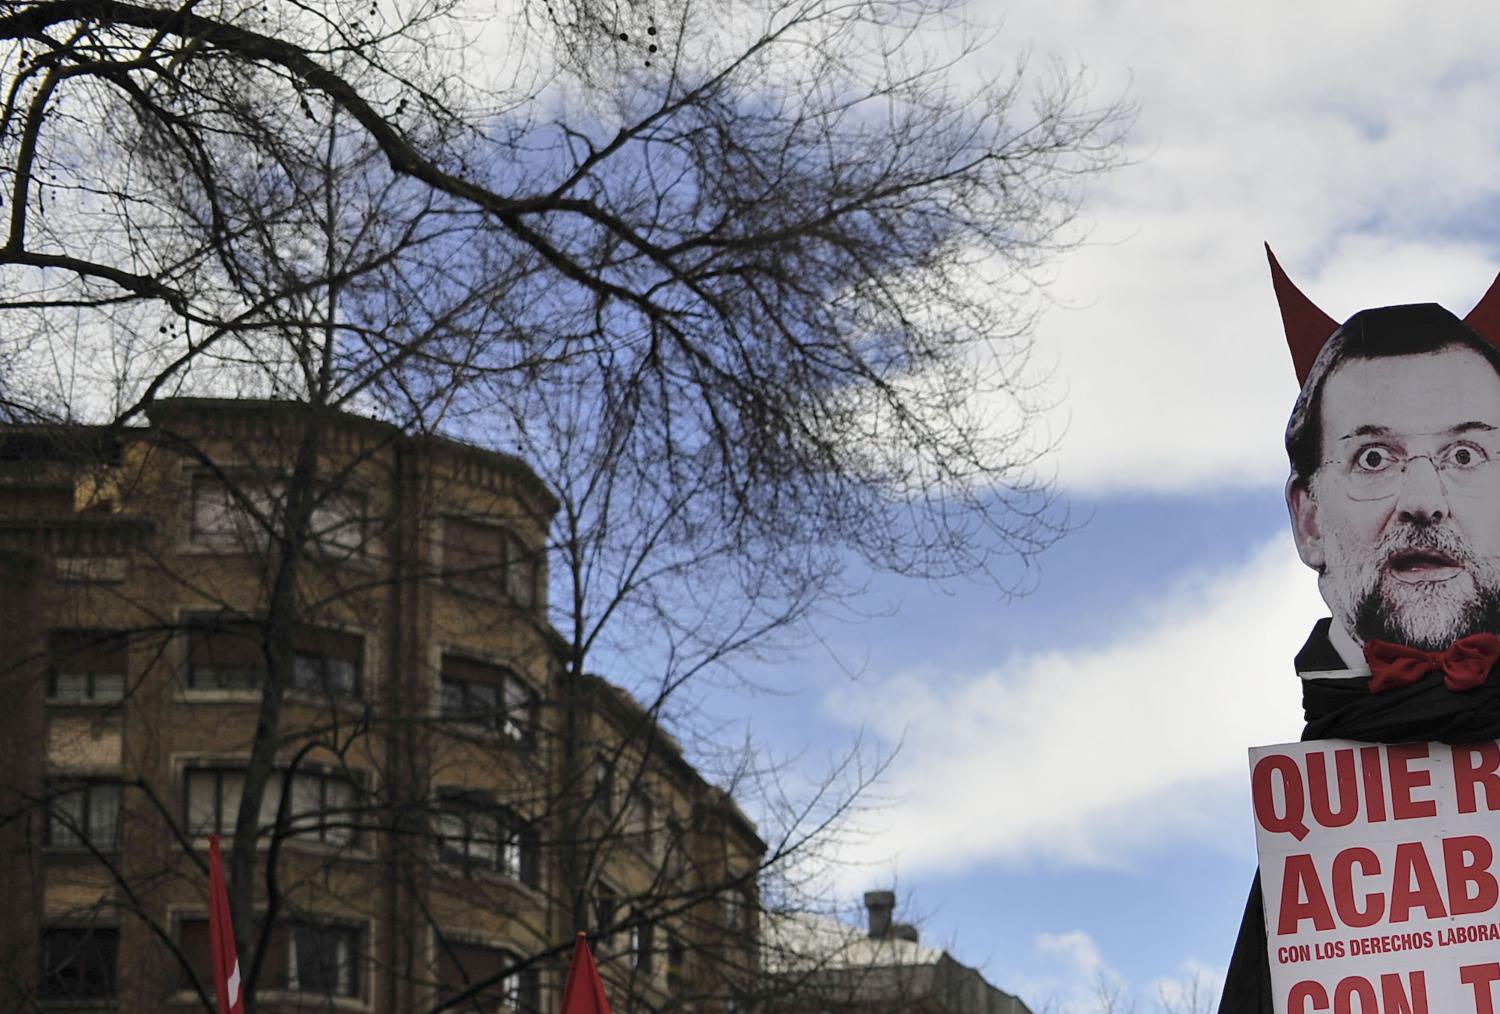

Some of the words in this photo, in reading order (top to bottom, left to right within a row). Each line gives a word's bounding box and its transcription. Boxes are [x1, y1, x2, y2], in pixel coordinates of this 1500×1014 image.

[1278, 945, 1310, 964] CON
[1315, 941, 1345, 960] LOS
[1350, 931, 1433, 956] DERECHOS
